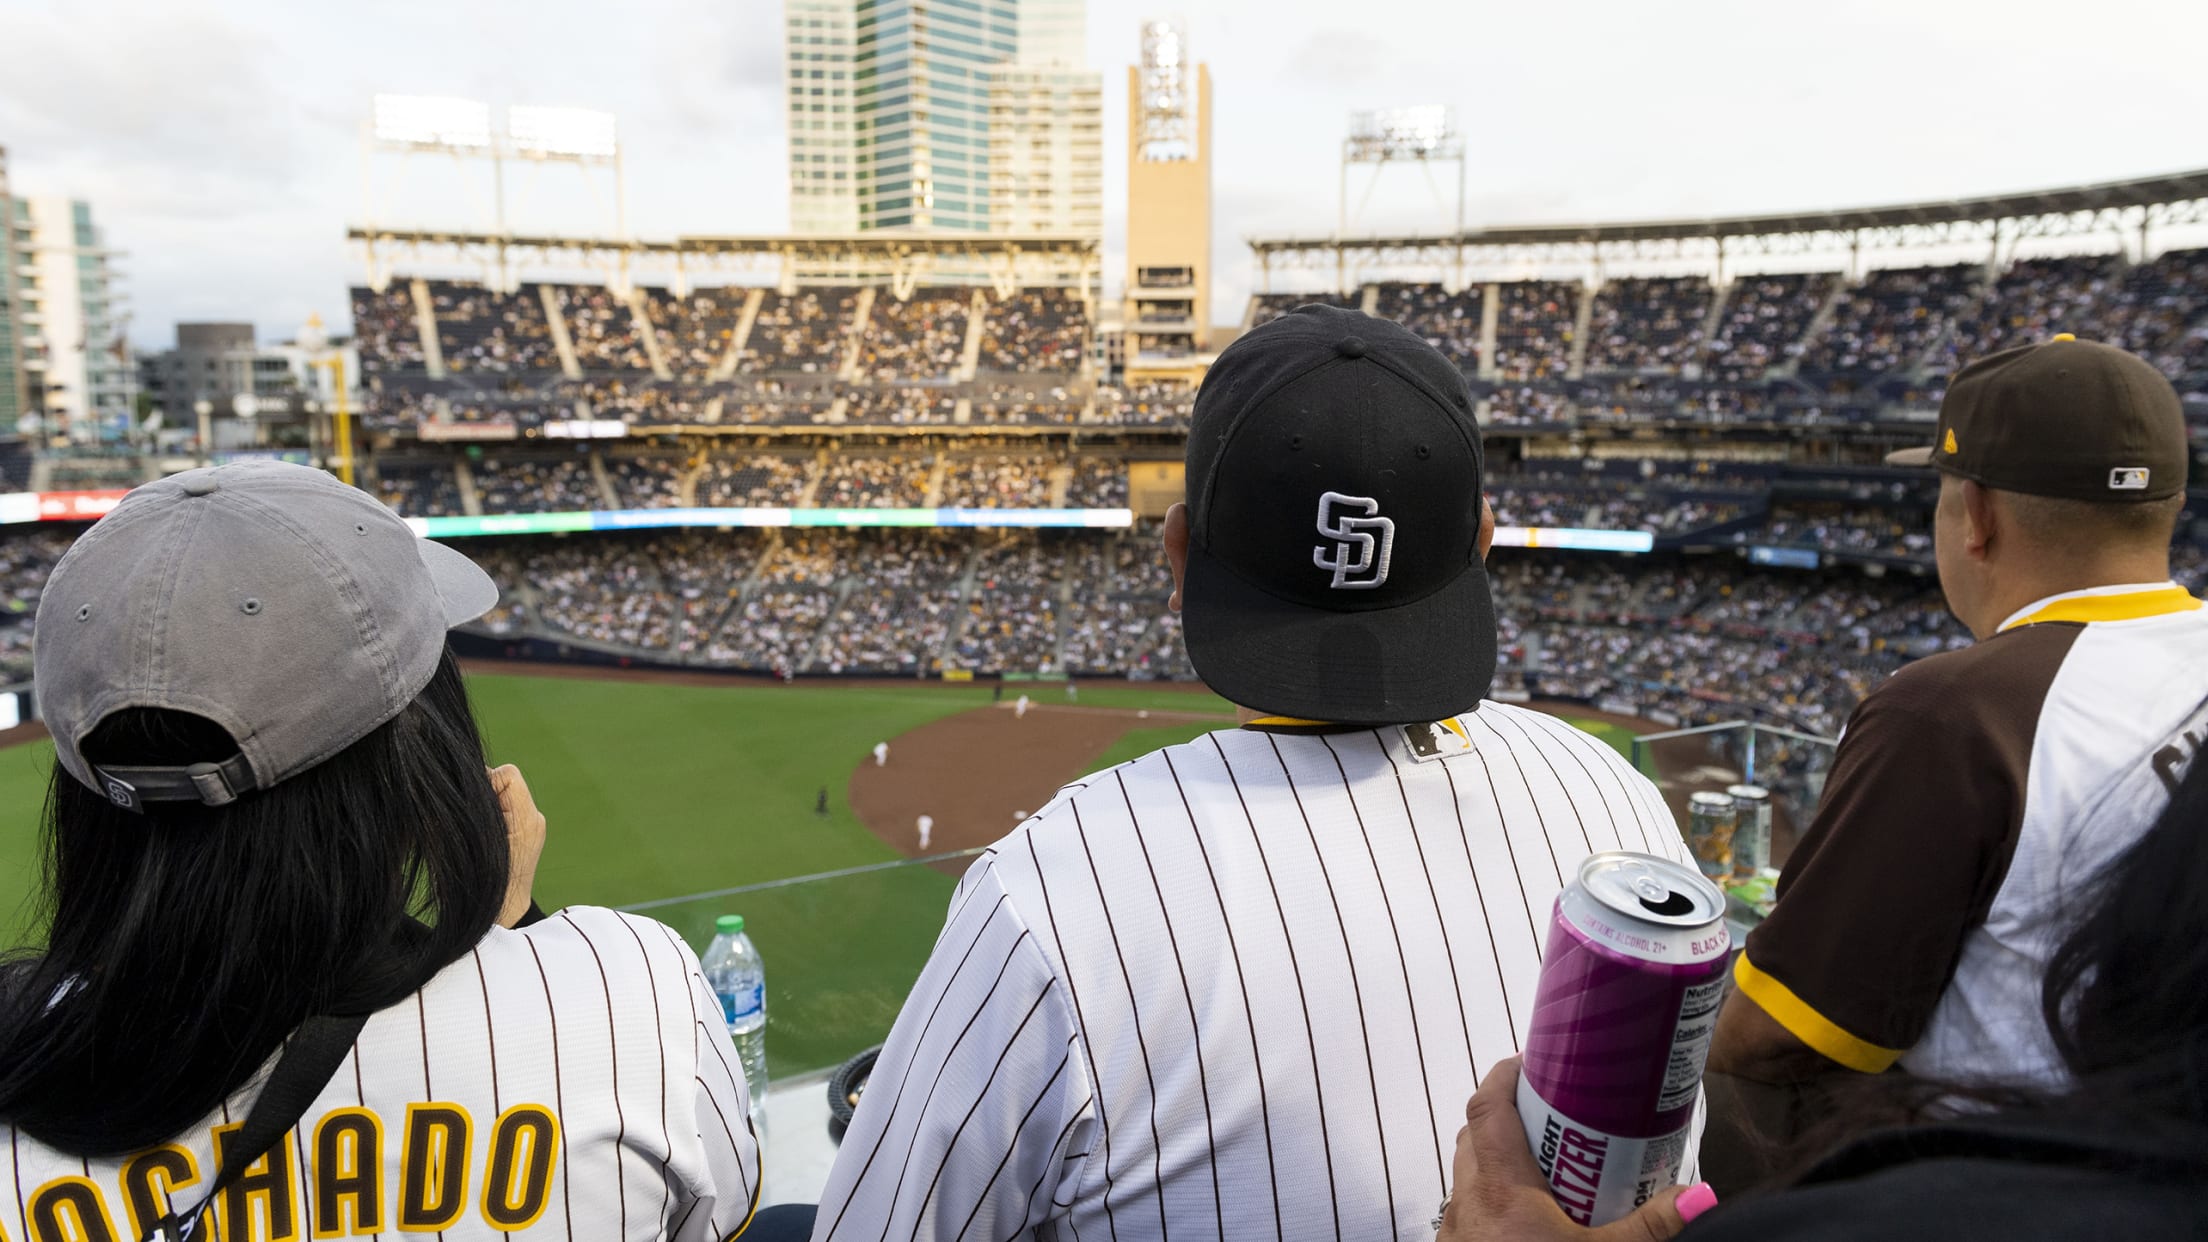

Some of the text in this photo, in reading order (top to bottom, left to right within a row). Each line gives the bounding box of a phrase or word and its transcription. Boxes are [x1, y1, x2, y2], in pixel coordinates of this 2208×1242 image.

[1313, 491, 1395, 589] SD
[1616, 931, 1650, 952] ALCOHOL
[1691, 936, 1719, 955] BLACK
[0, 1102, 561, 1242] ACHADO
[1539, 1114, 1562, 1178] LIGHT
